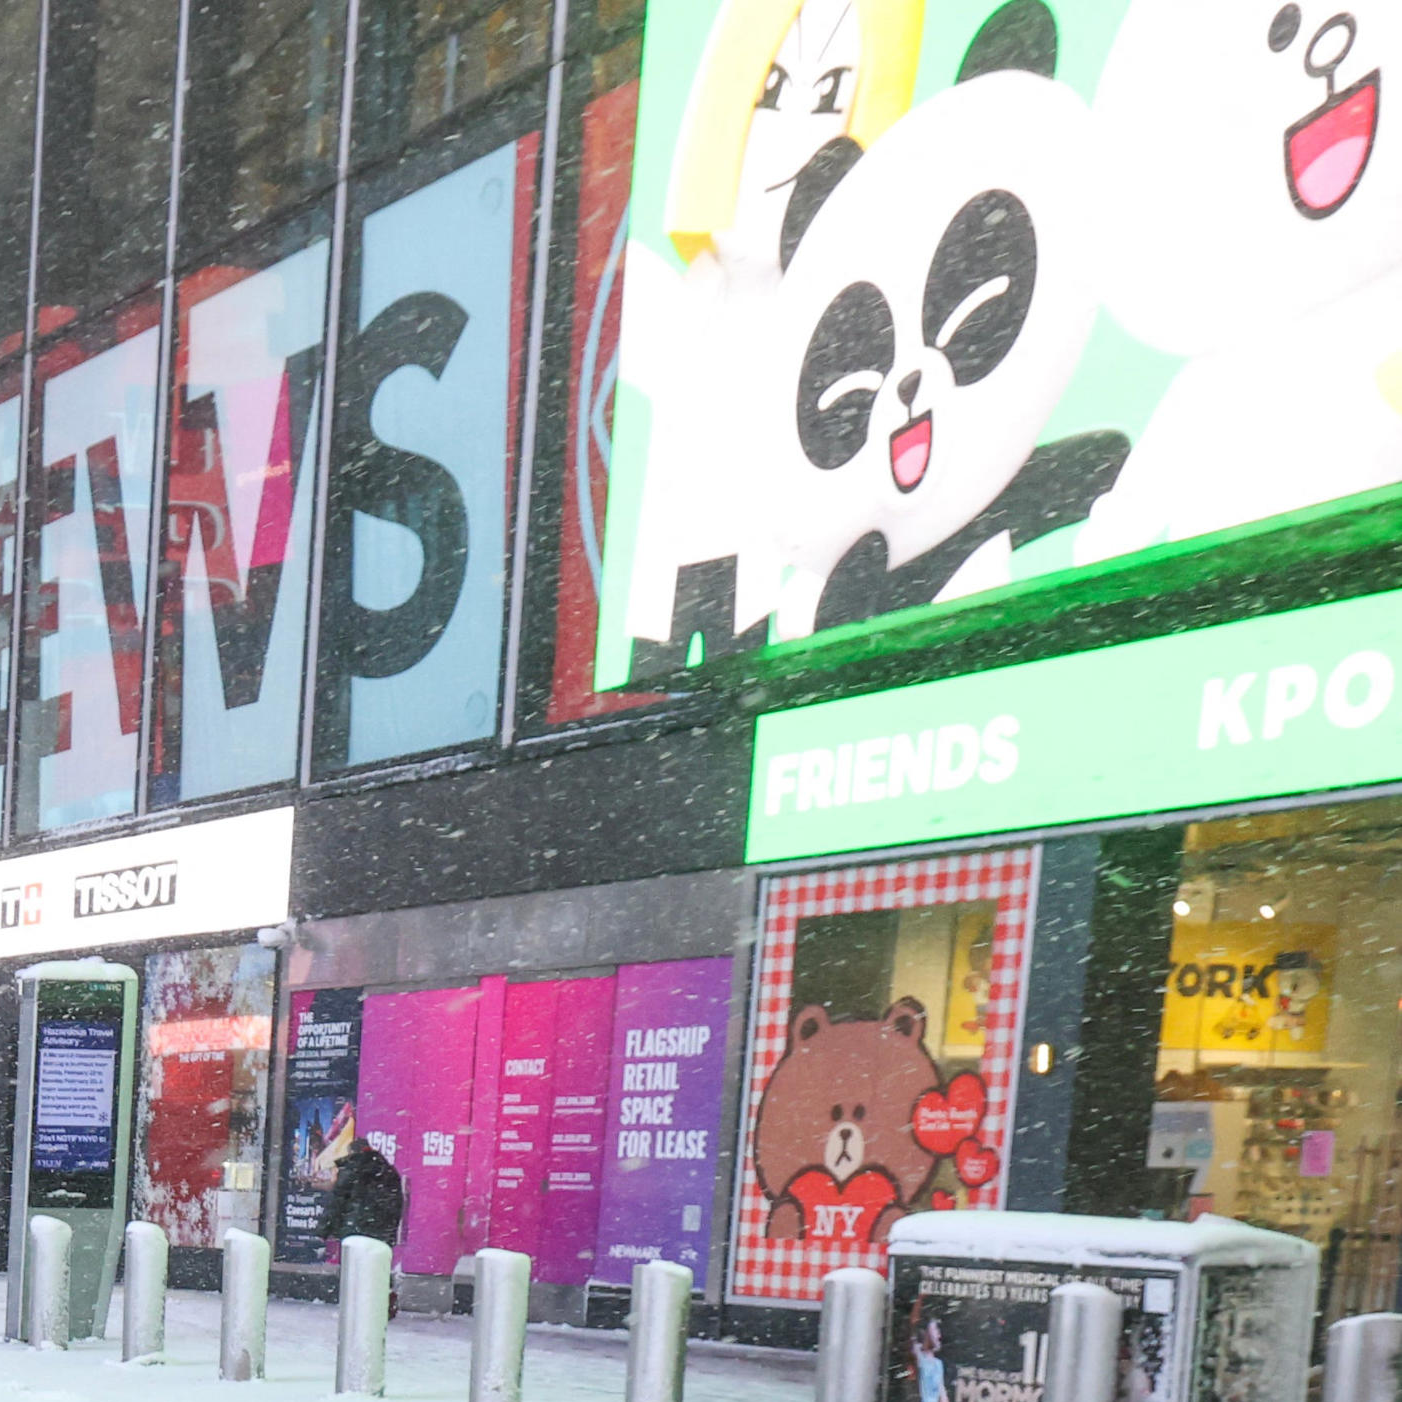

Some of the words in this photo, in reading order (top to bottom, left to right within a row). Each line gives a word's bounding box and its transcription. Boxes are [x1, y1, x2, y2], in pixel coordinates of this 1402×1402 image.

[764, 714, 1021, 816] FRIENDS
[75, 863, 178, 917] TISSOT
[298, 1011, 314, 1024] THE
[298, 1021, 352, 1036] OPPORTUNITY
[42, 1026, 88, 1038] Hazardous
[88, 1027, 114, 1039] Travel
[315, 1034, 350, 1048] LIFETIME
[624, 1025, 711, 1058] FLAGSHIP
[505, 1058, 546, 1076] CONTACT
[622, 1062, 680, 1092] RETAIL
[620, 1096, 675, 1126] SPACE
[617, 1130, 652, 1159] FOR
[654, 1130, 709, 1160] LEASE
[286, 1216, 308, 1229] Times
[812, 1204, 865, 1238] NY
[608, 1244, 662, 1260] NEWMARK
[920, 1265, 944, 1281] THE
[945, 1267, 1005, 1284] FUNNIEST
[1005, 1271, 1061, 1287] MUSICAL
[920, 1280, 990, 1299] CELEBRATES
[1011, 1286, 1049, 1303] YEARS
